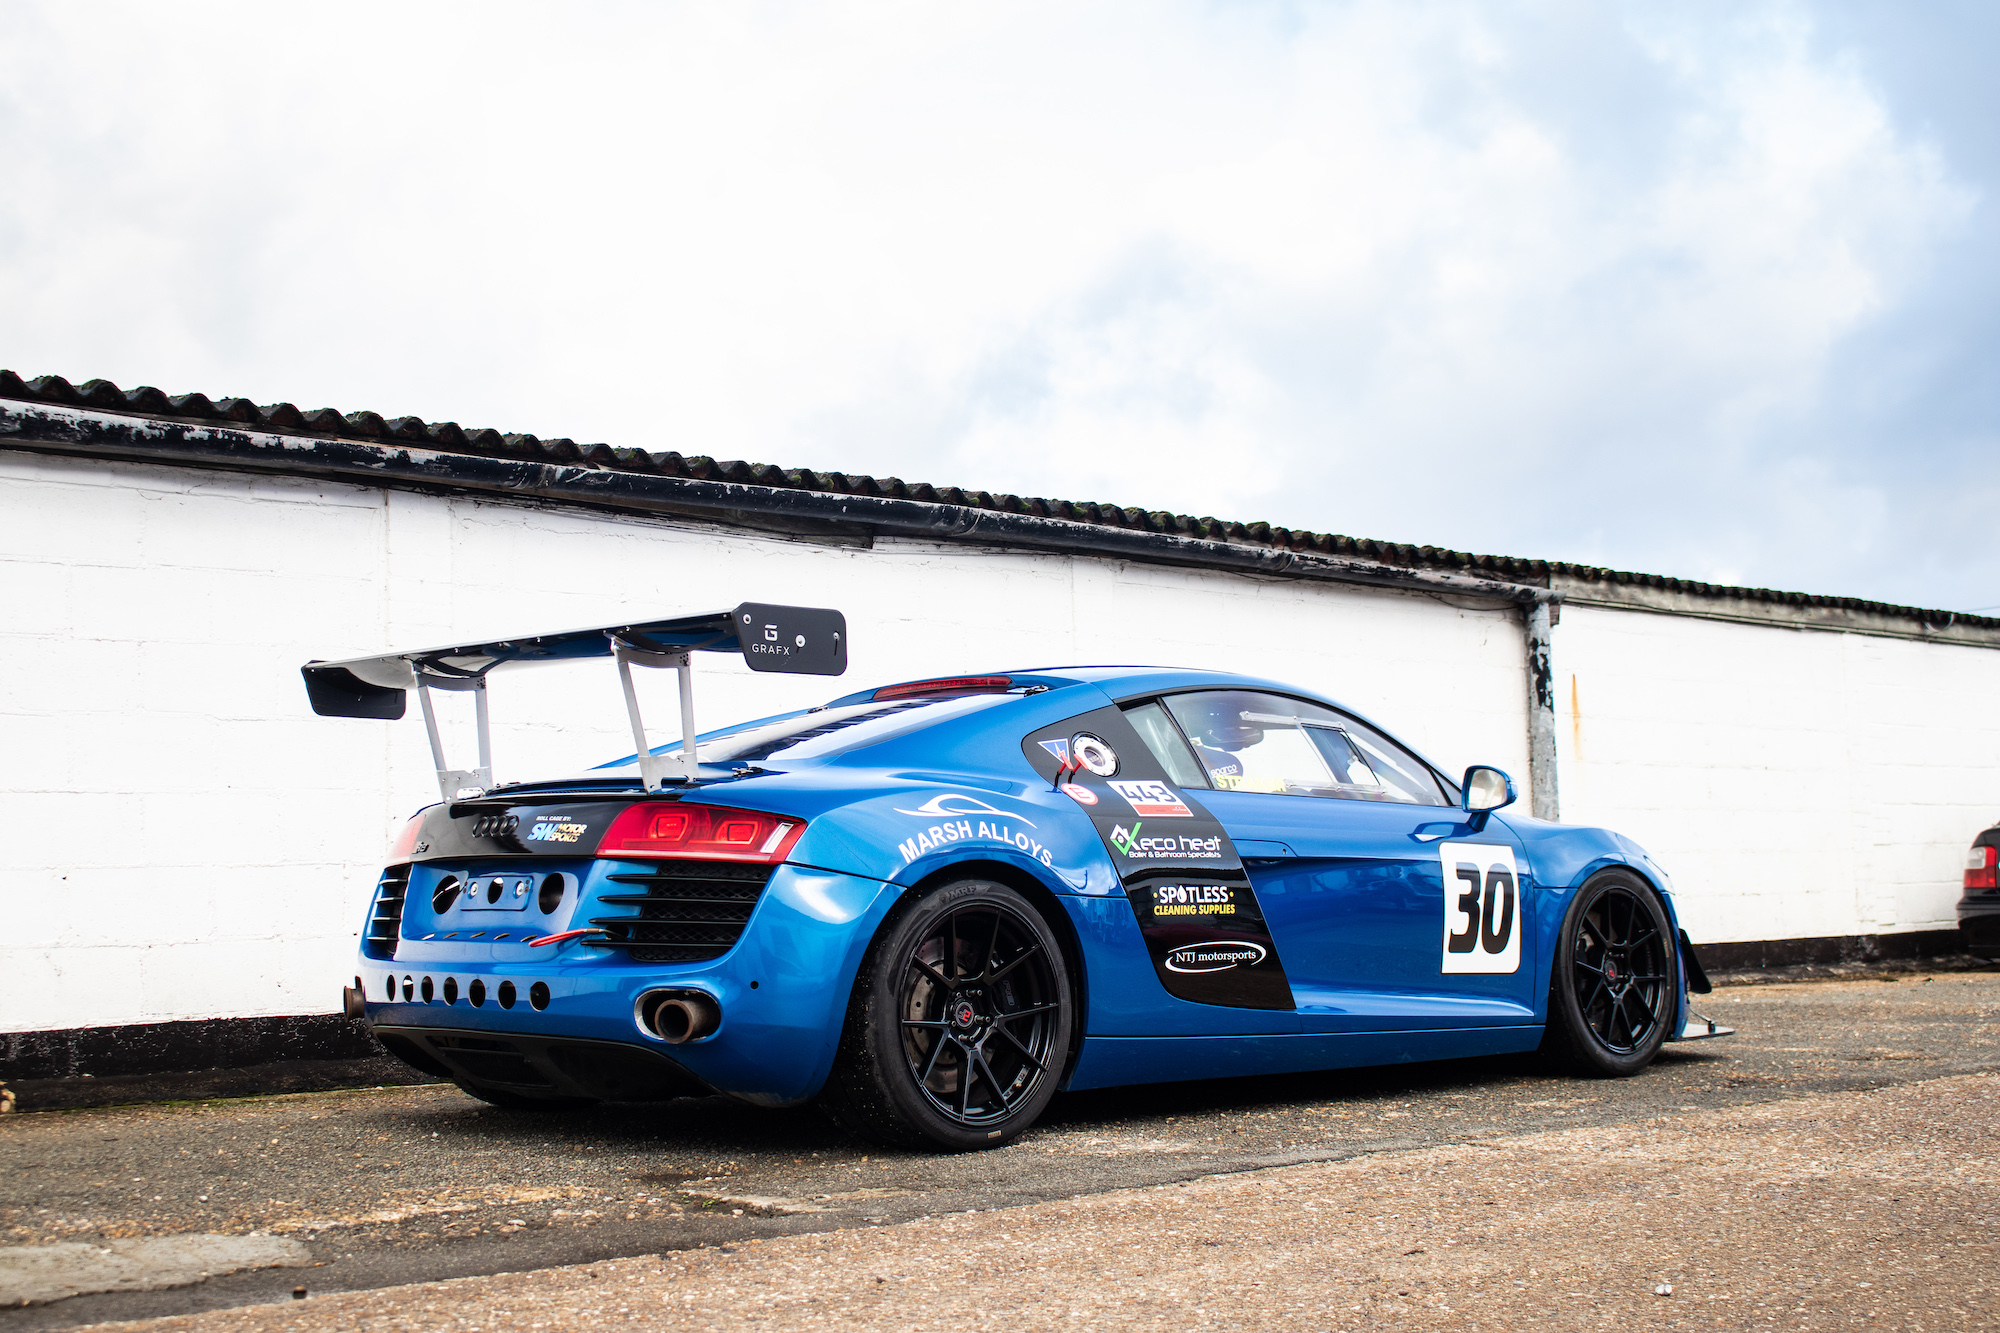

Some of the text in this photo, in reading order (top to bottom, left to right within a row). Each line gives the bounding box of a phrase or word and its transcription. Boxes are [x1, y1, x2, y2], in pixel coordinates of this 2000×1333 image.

[752, 643, 790, 656] GRAFX
[1210, 764, 1237, 777] sparco
[1069, 787, 1090, 799] E
[1118, 785, 1177, 803] 443
[527, 823, 560, 840] SW
[557, 823, 588, 834] MOTOR
[549, 832, 580, 842] SPORTS
[898, 820, 1053, 867] MARSH ALLOYS
[1140, 835, 1221, 851] eco heat
[949, 885, 976, 899] MRF
[1159, 885, 1229, 903] SPOTLESS
[1154, 904, 1236, 916] CLEANING SUPPLIES
[1448, 861, 1514, 954] 30
[1176, 951, 1257, 963] NTJ motorsports
